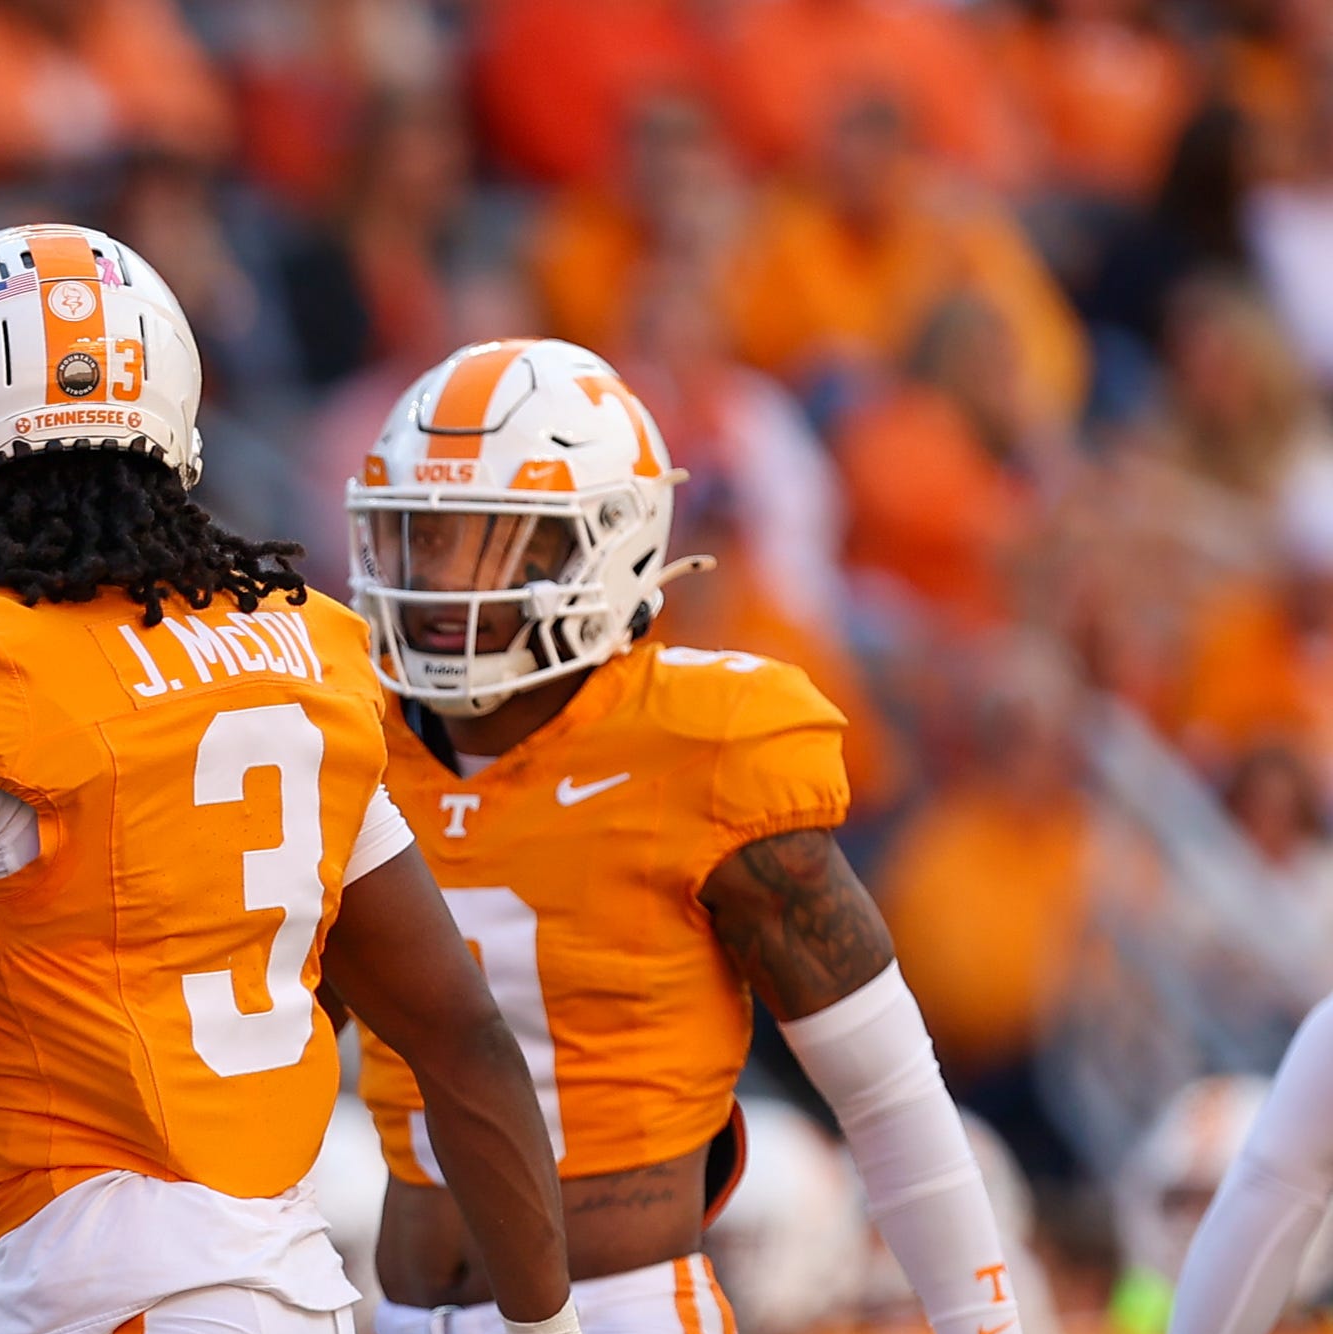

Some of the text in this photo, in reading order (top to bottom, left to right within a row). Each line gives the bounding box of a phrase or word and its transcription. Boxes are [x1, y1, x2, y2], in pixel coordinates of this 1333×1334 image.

[59, 354, 97, 371] MOUNTAIN
[112, 338, 145, 402] 3
[65, 385, 94, 396] STRONG
[34, 410, 125, 429] TENNESSEE
[415, 463, 475, 483] VOLS
[117, 624, 184, 697] J.
[440, 794, 480, 838] T
[181, 703, 325, 1078] 3
[974, 1263, 1008, 1304] T
